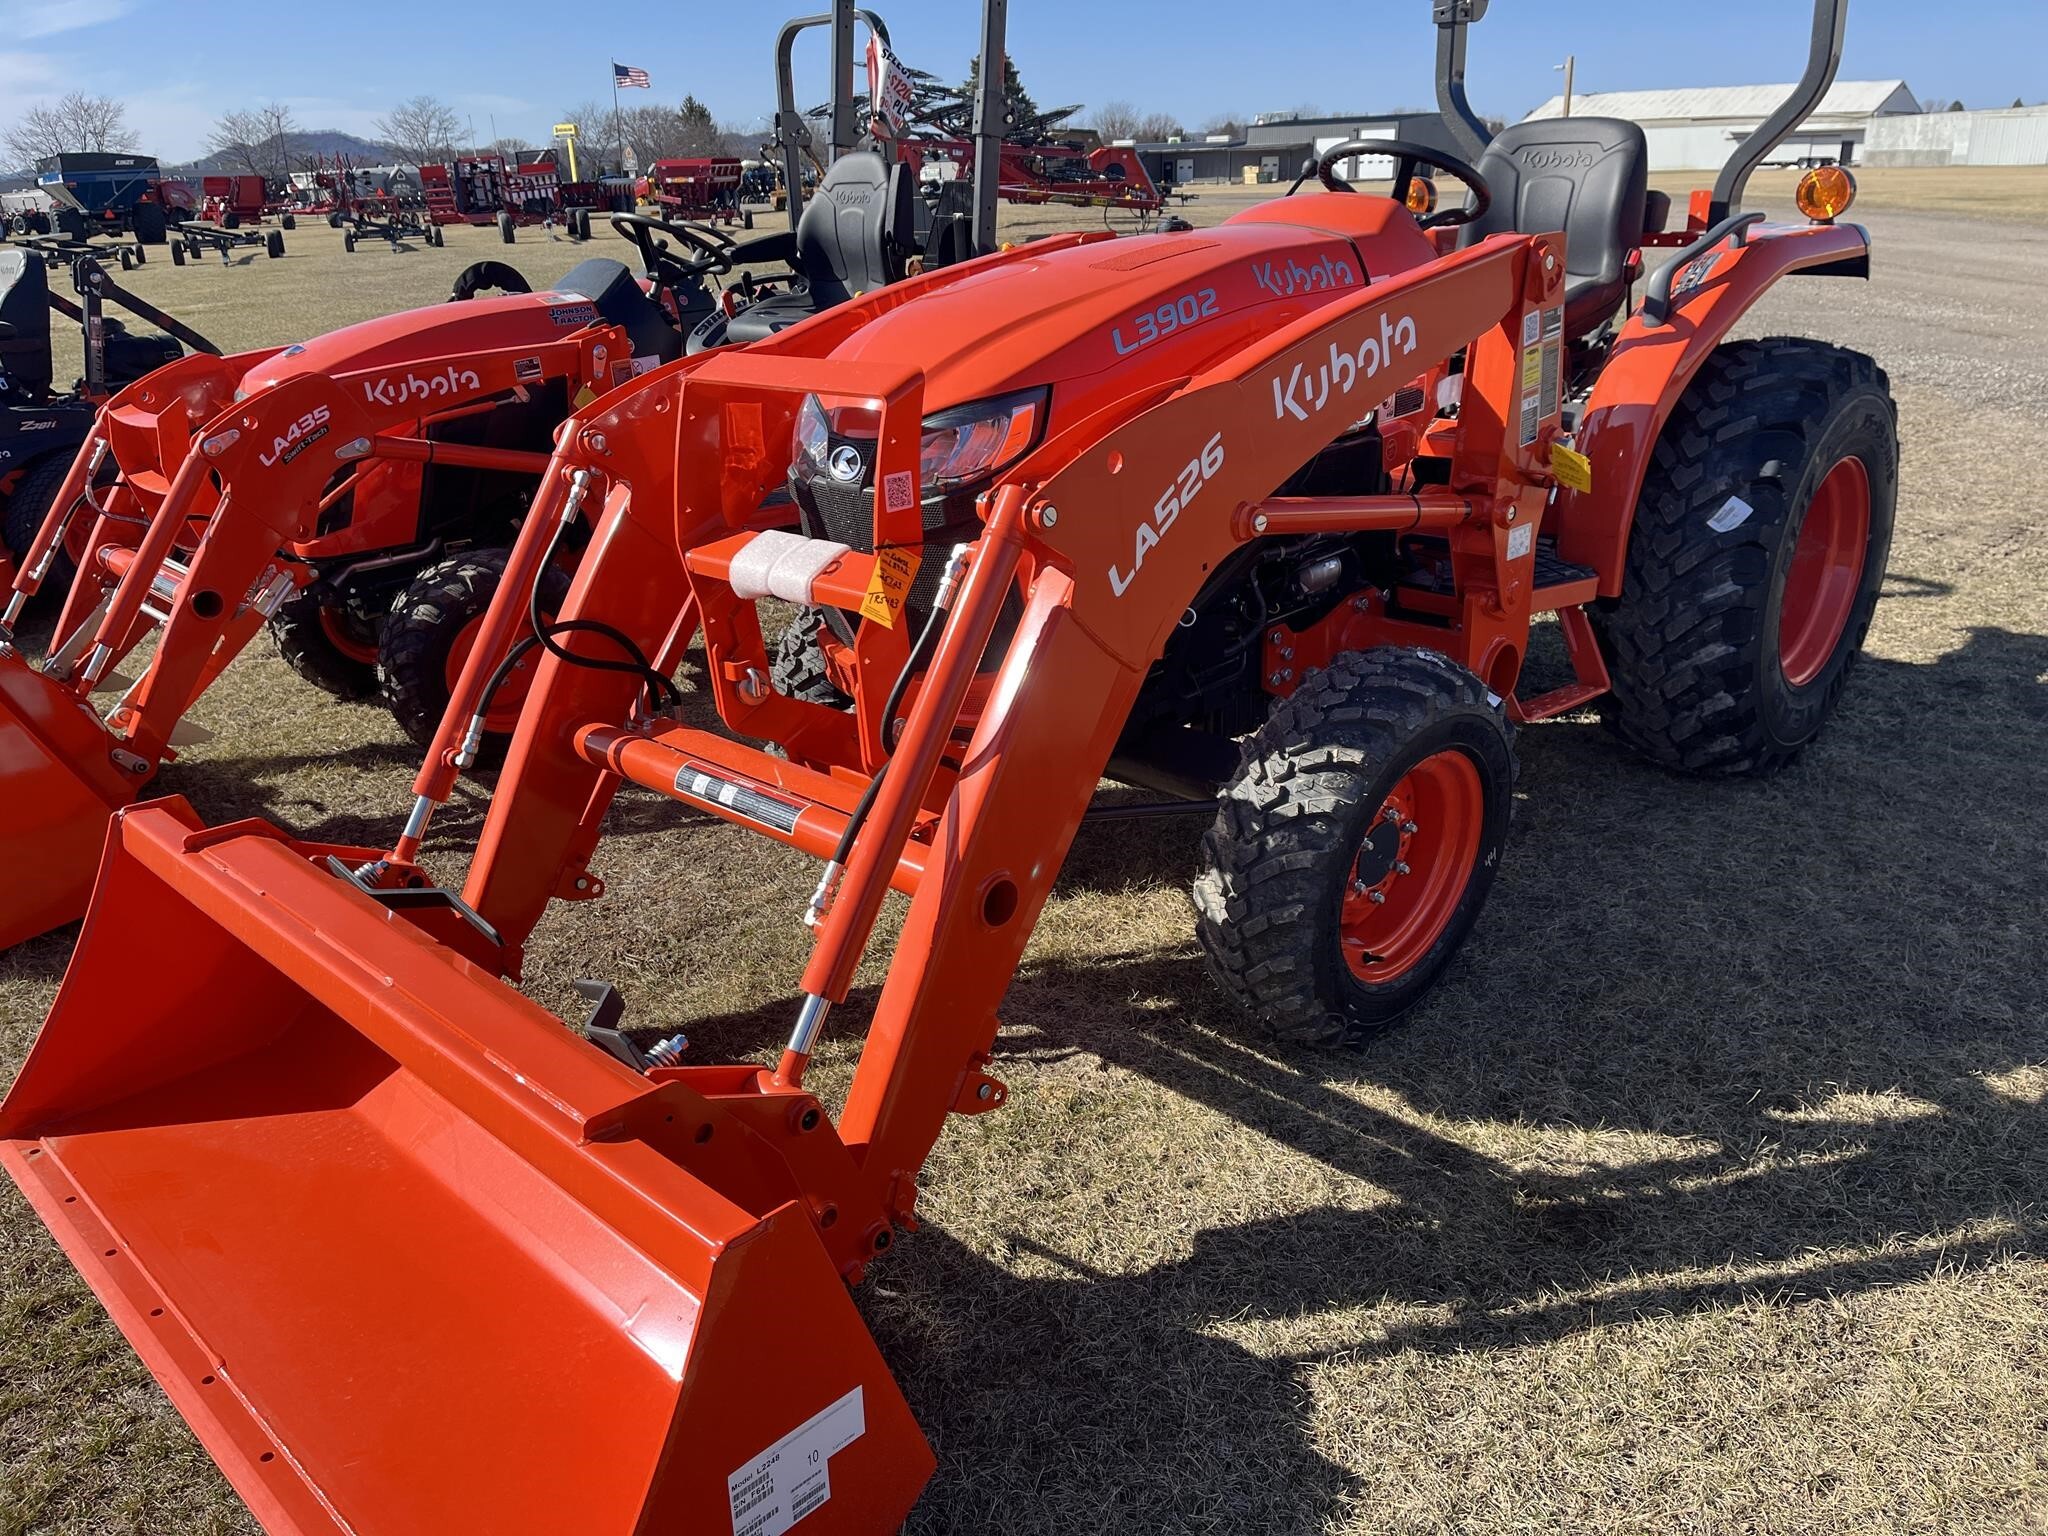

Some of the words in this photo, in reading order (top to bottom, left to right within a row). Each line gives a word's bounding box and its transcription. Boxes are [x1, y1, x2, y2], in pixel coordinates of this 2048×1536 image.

[881, 48, 911, 80] SELECT
[1522, 150, 1593, 168] Kubota
[835, 190, 871, 204] Kubota
[1252, 254, 1353, 296] Kubota
[549, 305, 592, 316] JOHNSON
[1112, 288, 1219, 354] L3902
[363, 366, 480, 405] Kubota
[1272, 312, 1417, 421] Kubota
[259, 404, 331, 467] LA435
[1108, 431, 1225, 597] LA526
[731, 1473, 753, 1493] Model
[756, 1453, 780, 1475] L2248
[807, 1449, 819, 1467] 10
